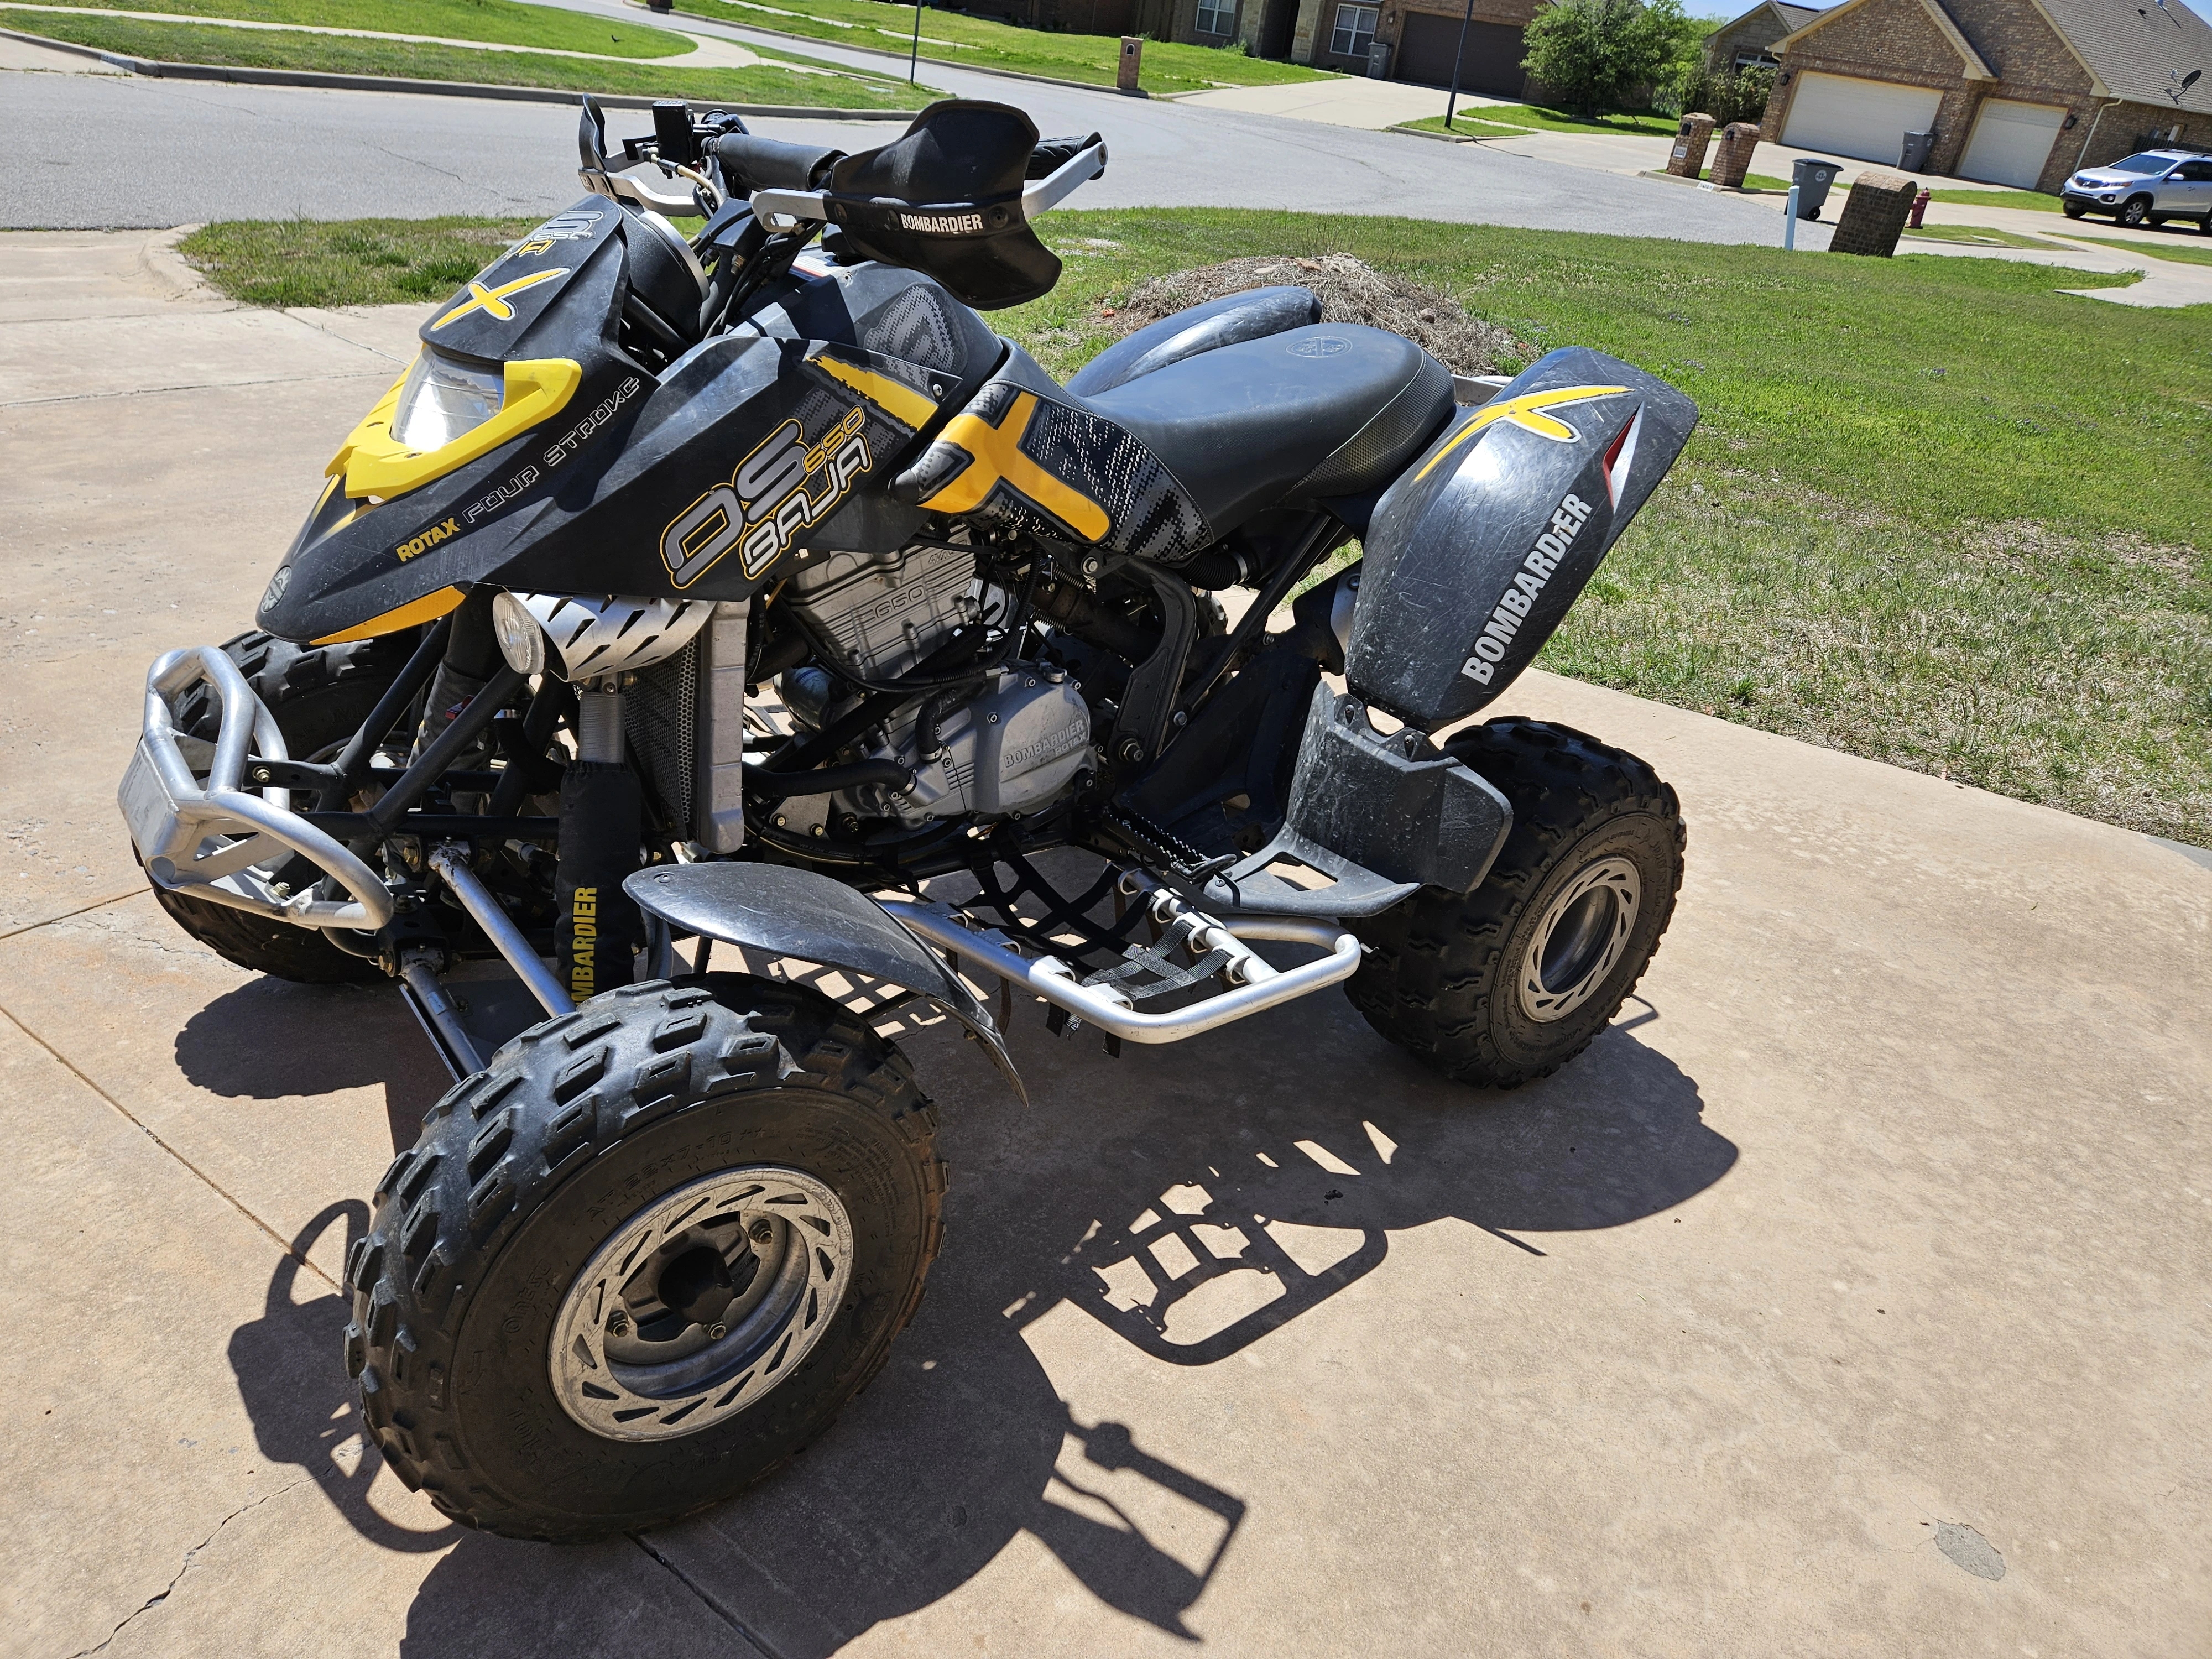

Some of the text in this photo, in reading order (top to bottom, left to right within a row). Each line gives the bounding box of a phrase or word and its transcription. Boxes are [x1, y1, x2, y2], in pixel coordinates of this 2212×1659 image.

[900, 213, 984, 232] BOMBARDIER
[395, 376, 640, 562] ROTAX FOUR STROKE
[660, 405, 865, 588] DS 650
[741, 434, 872, 578] BAJA
[1460, 493, 1593, 686] BOMBARDIER
[1003, 719, 1085, 768] BOMBARDIER
[1053, 732, 1087, 757] ROTAX
[571, 886, 597, 1006] MBARDIER
